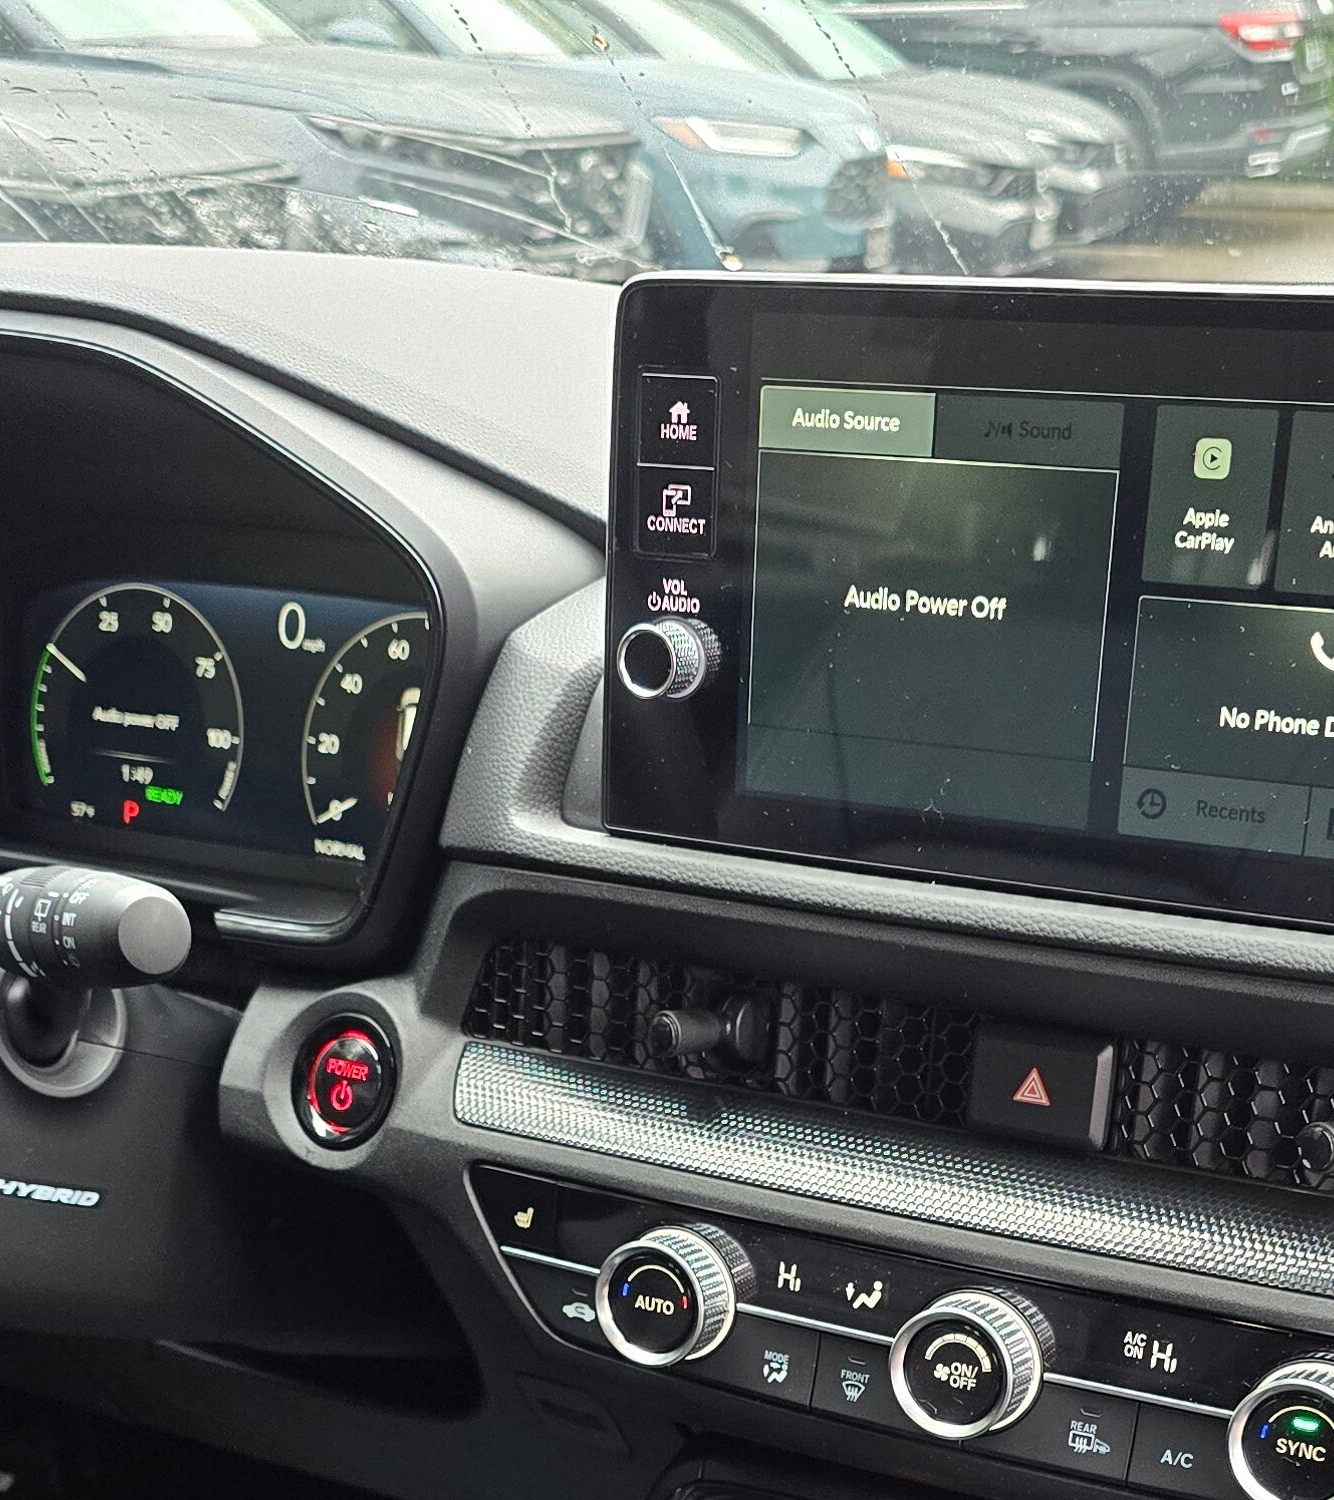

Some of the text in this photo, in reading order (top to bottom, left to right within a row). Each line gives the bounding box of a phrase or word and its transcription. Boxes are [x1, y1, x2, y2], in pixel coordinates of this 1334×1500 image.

[791, 408, 901, 433] Audio Source
[1018, 420, 1073, 441] Sound
[660, 423, 697, 441] HOME
[647, 516, 706, 535] CONNECT
[1182, 507, 1230, 529] Apple
[1174, 530, 1235, 555] CarPlay
[662, 578, 687, 596] VOL
[662, 596, 700, 614] AUDIO
[843, 584, 1007, 621] Audio Power Off
[98, 611, 119, 632] 25
[151, 611, 173, 633] 50
[278, 602, 306, 649] 0
[388, 639, 410, 661] 60
[195, 656, 216, 679] 75
[340, 673, 363, 695] 40
[1219, 705, 1250, 729] No
[1254, 709, 1320, 736] Phone
[317, 732, 340, 755] 20
[123, 800, 140, 824] P
[1195, 796, 1267, 826] Recents
[327, 1058, 368, 1081] POWER
[634, 1295, 674, 1317] AUTO
[1123, 1331, 1147, 1349] A/C
[764, 1350, 790, 1364] MODE
[1123, 1345, 1144, 1361] ON
[840, 1369, 870, 1385] FRONT
[950, 1361, 978, 1378] ON/
[949, 1375, 978, 1392] OFF
[1070, 1420, 1098, 1435] REAR
[1160, 1448, 1194, 1469] A/C
[1275, 1437, 1326, 1463] SYNC
